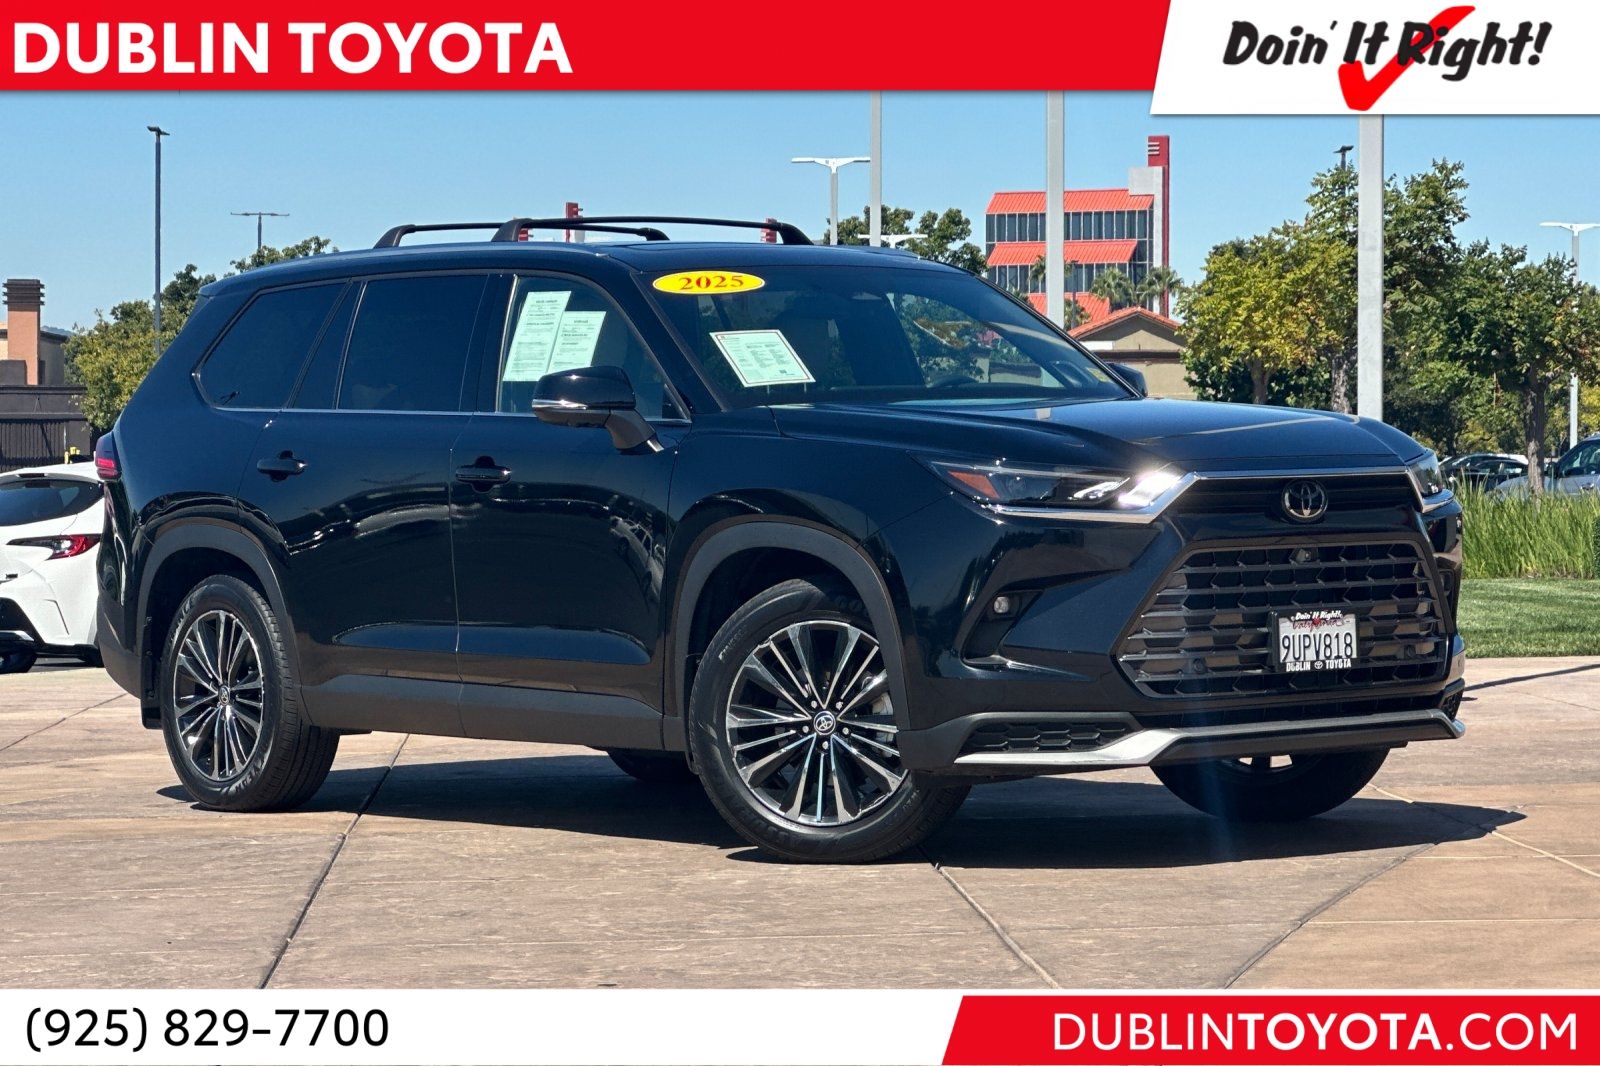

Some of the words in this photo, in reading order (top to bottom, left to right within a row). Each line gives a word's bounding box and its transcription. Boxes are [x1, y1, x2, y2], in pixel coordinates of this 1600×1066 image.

[679, 275, 744, 290] 2025
[1282, 632, 1353, 661] 9UPV818
[1286, 661, 1311, 672] DUBLIN
[1325, 659, 1352, 669] TOYOTA
